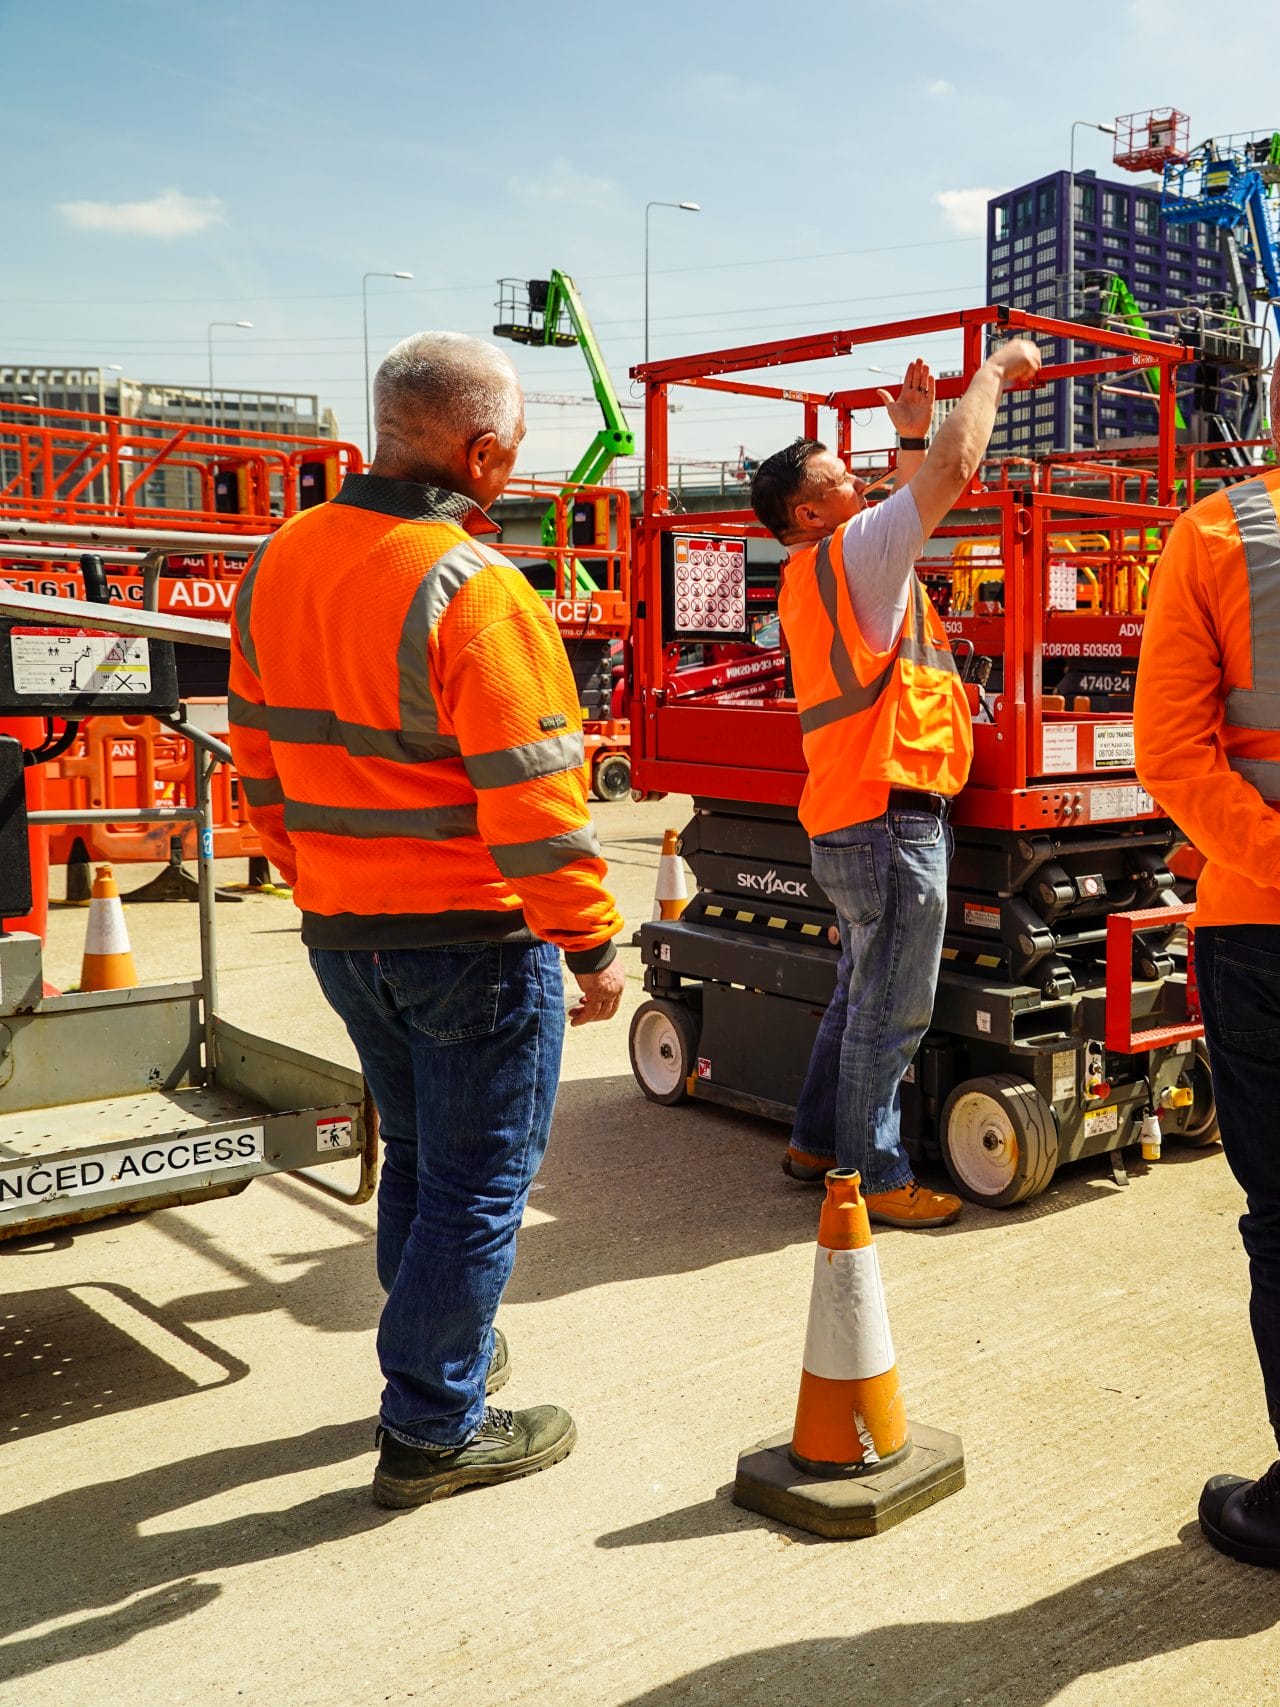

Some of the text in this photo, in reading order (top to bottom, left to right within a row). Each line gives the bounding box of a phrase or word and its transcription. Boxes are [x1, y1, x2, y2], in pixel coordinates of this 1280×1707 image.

[1083, 644, 1122, 657] 503503
[737, 869, 809, 898] SKYJACK
[117, 1133, 257, 1181] ACCESS
